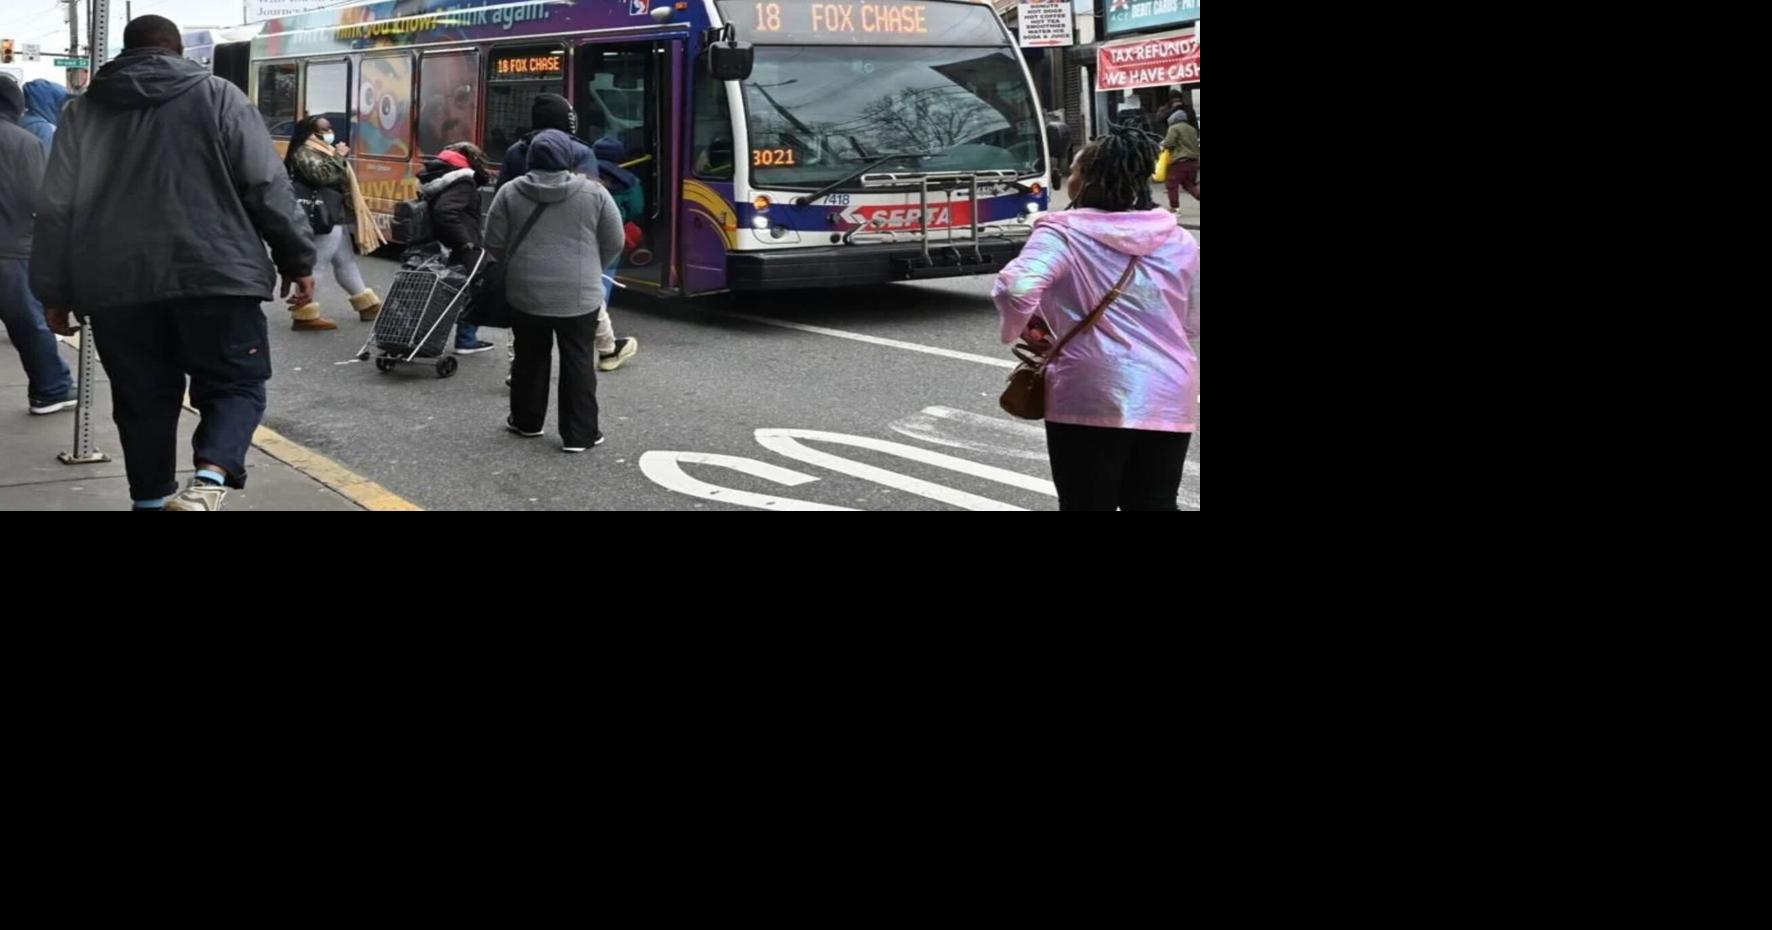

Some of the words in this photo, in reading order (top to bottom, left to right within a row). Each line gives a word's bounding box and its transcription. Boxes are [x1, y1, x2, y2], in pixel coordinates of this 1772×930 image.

[755, 3, 781, 31] 18
[811, 4, 853, 32] FOX
[860, 5, 927, 33] CHASE
[510, 58, 528, 72] FOX
[529, 56, 561, 71] CHASE
[1110, 48, 1134, 63] TAX
[1105, 71, 1127, 86] WE
[1129, 66, 1166, 84] HAVE
[1167, 62, 1200, 80] CASH
[752, 149, 796, 166] 3021
[824, 193, 850, 205] 7418
[870, 207, 950, 229] SEPTA
